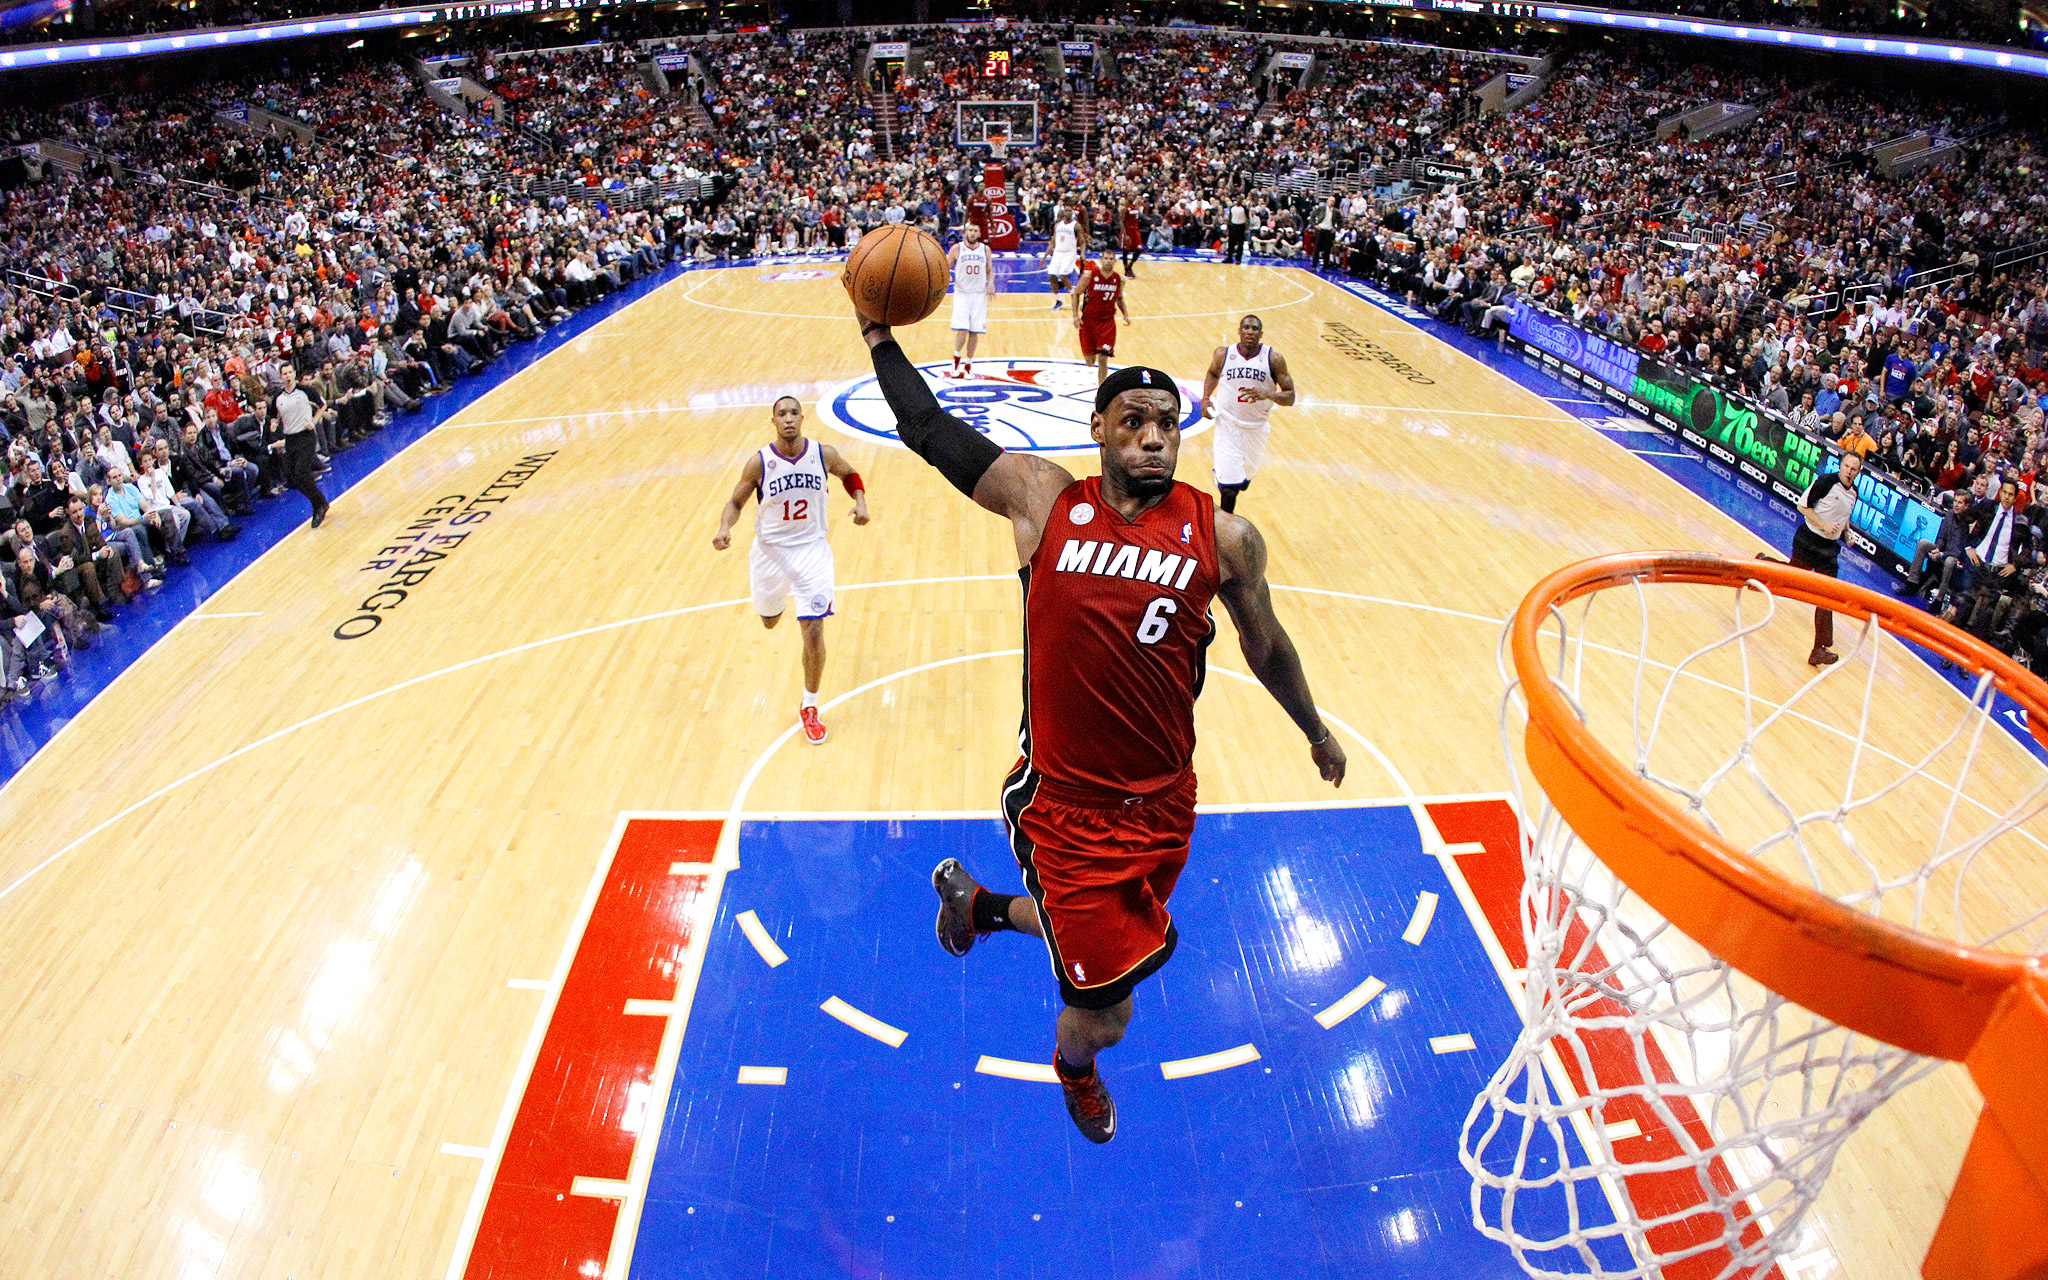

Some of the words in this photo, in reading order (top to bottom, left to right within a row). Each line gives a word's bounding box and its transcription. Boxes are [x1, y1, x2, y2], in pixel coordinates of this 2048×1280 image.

[988, 51, 1010, 61] 3:50
[983, 60, 1008, 77] 21
[1437, 169, 1465, 179] LEXUS
[987, 188, 1002, 196] KIA
[966, 265, 980, 275] 00
[1093, 283, 1118, 292] MIAMI
[1102, 291, 1115, 301] 31
[1586, 333, 1608, 358] WE
[1609, 344, 1640, 374] LIVE
[1226, 367, 1267, 383] SIXERS
[1654, 412, 1678, 432] GEICO
[1682, 428, 1707, 448] GEICO
[1719, 400, 1778, 469] 76ers
[1709, 443, 1736, 464] GEICO
[1783, 431, 1822, 470] PRE
[1740, 460, 1768, 484] GEICO
[449, 450, 560, 526] WELLS
[769, 473, 822, 497] SIXERS
[1772, 481, 1801, 506] GEICO
[781, 499, 809, 522] 12
[1851, 499, 1888, 538] IVE
[359, 494, 467, 572] CENTER
[1055, 539, 1199, 591] MIAMI
[333, 530, 472, 640] FARGO
[1136, 597, 1178, 645] 6
